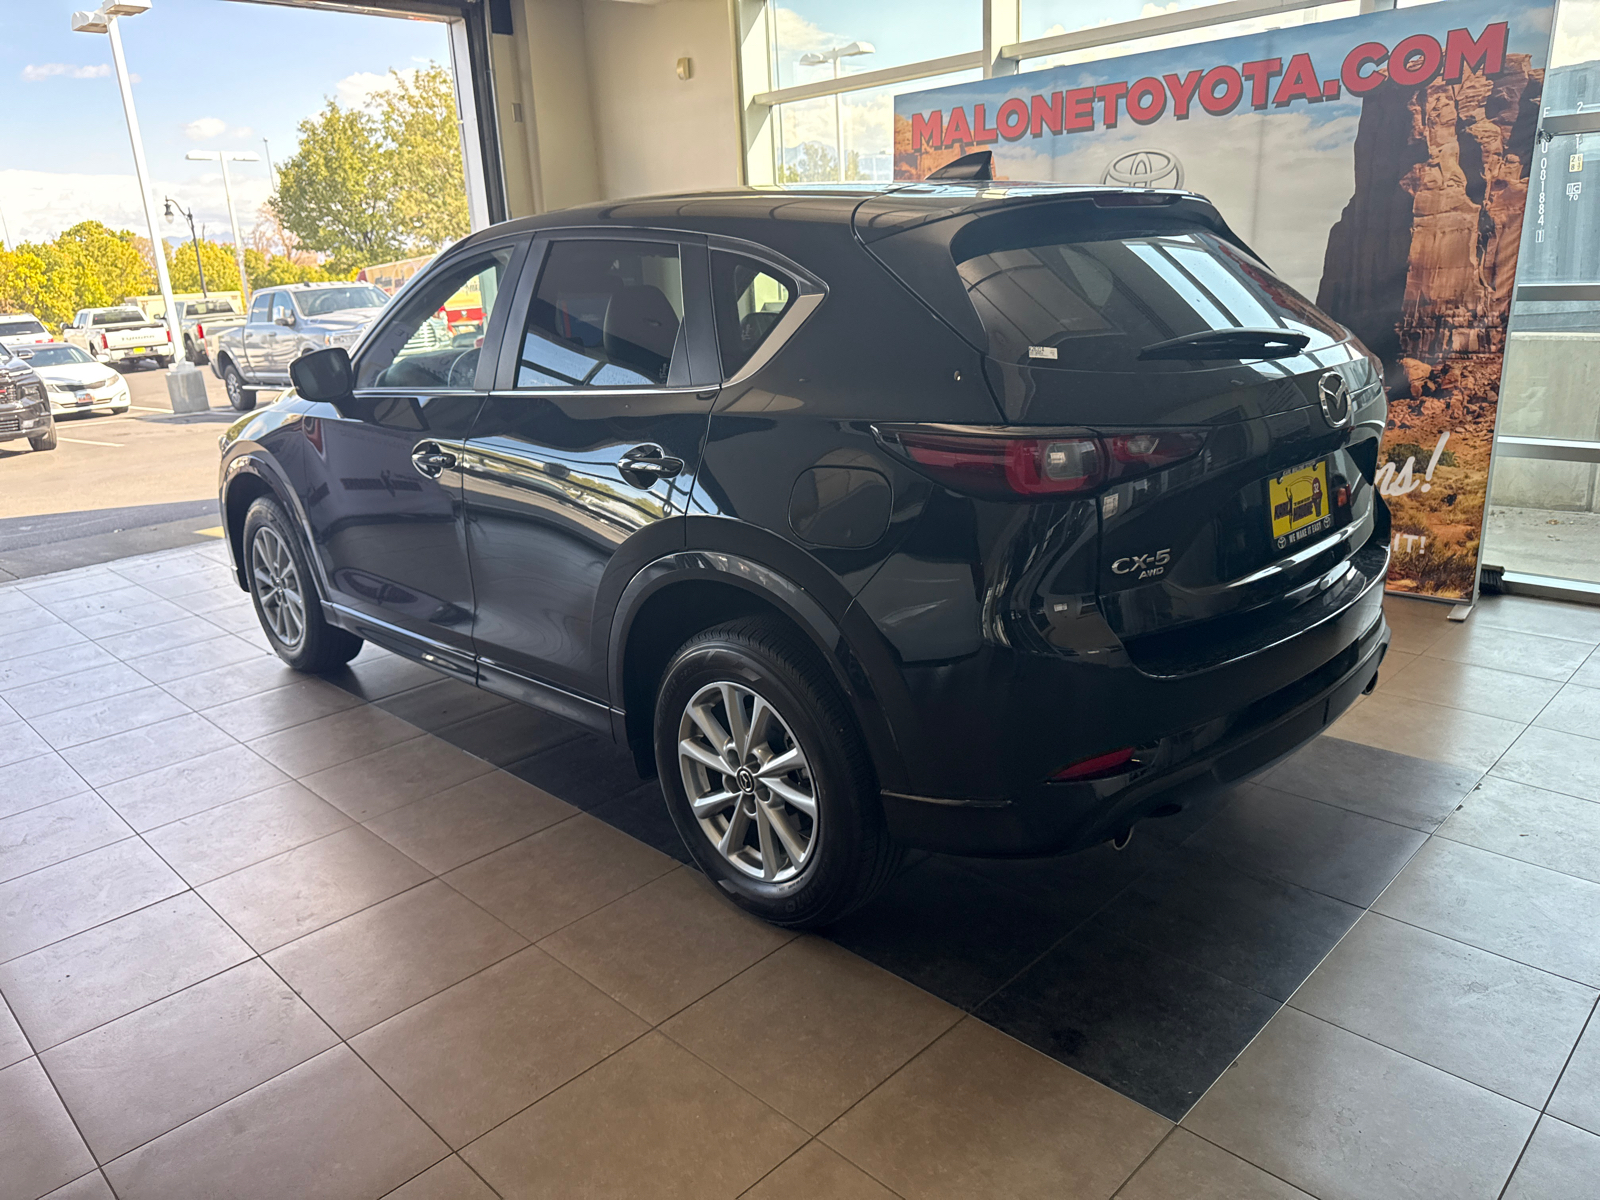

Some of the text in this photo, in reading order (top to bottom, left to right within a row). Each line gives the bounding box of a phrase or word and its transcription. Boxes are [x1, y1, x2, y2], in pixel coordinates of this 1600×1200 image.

[911, 21, 1509, 151] MALONETOYOTA.COM
[1375, 431, 1450, 496] ns!
[1296, 528, 1307, 540] MAKE
[1393, 533, 1426, 554] IT!
[1111, 548, 1171, 575] CX-5
[1138, 566, 1164, 580] AWD
